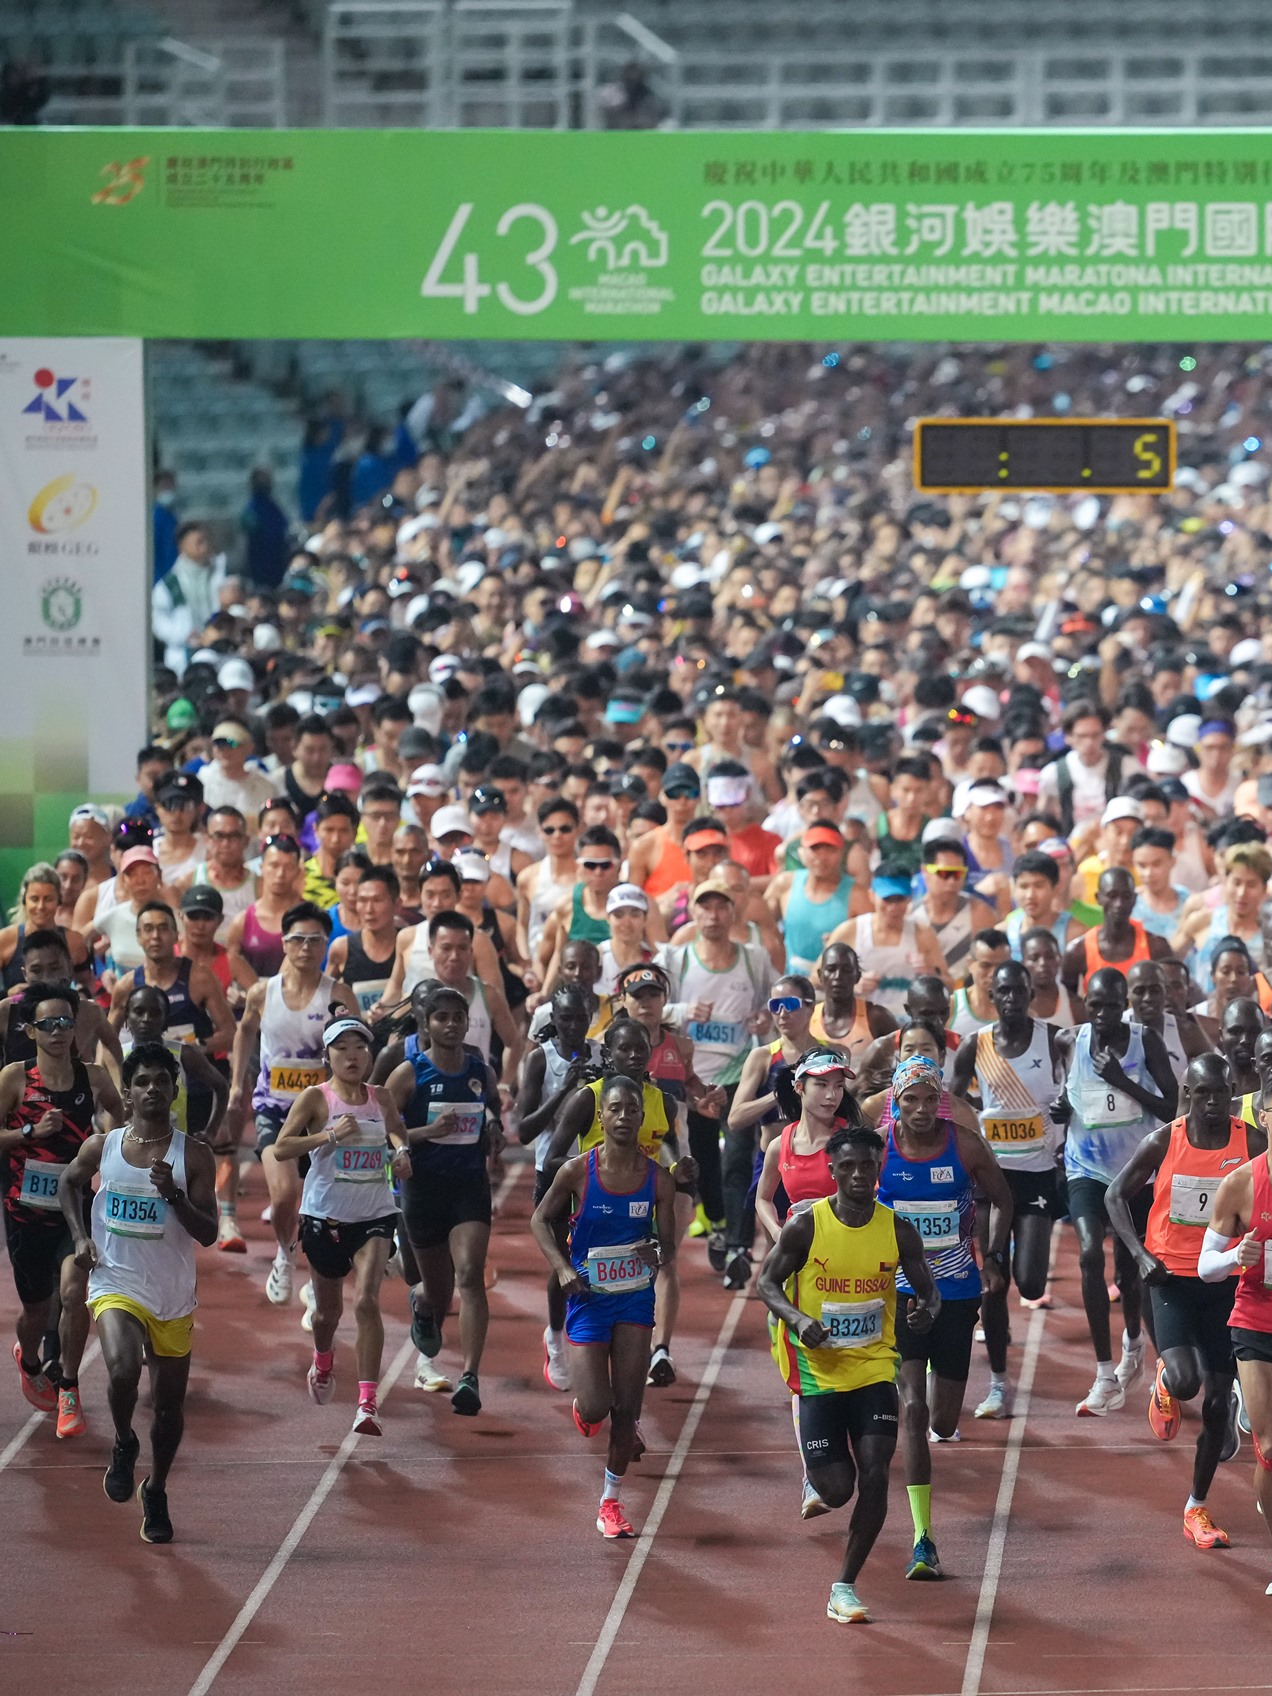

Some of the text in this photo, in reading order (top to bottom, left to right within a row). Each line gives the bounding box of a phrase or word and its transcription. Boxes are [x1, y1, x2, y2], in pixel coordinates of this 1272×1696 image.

[421, 203, 558, 315] 43
[701, 264, 800, 287] GALAXY
[805, 264, 1018, 287] ENTERTAINMENT
[1024, 264, 1163, 287] MARATONA
[701, 292, 804, 316] GALAXY
[810, 292, 1033, 316] ENTERTAINMENT
[1038, 292, 1132, 315] MACAO
[276, 1071, 320, 1090] A4432
[1106, 1093, 1116, 1112] 8
[991, 1121, 1036, 1140] A1036
[342, 1150, 382, 1170] B7269
[30, 1174, 60, 1197] B13
[111, 1196, 158, 1222] B1354
[1198, 1192, 1208, 1212] 9
[902, 1215, 952, 1236] 1353
[595, 1255, 643, 1282] B6633
[815, 1276, 892, 1294] GUINE BISSAU
[829, 1314, 877, 1338] B3243
[806, 1438, 829, 1451] CRIS
